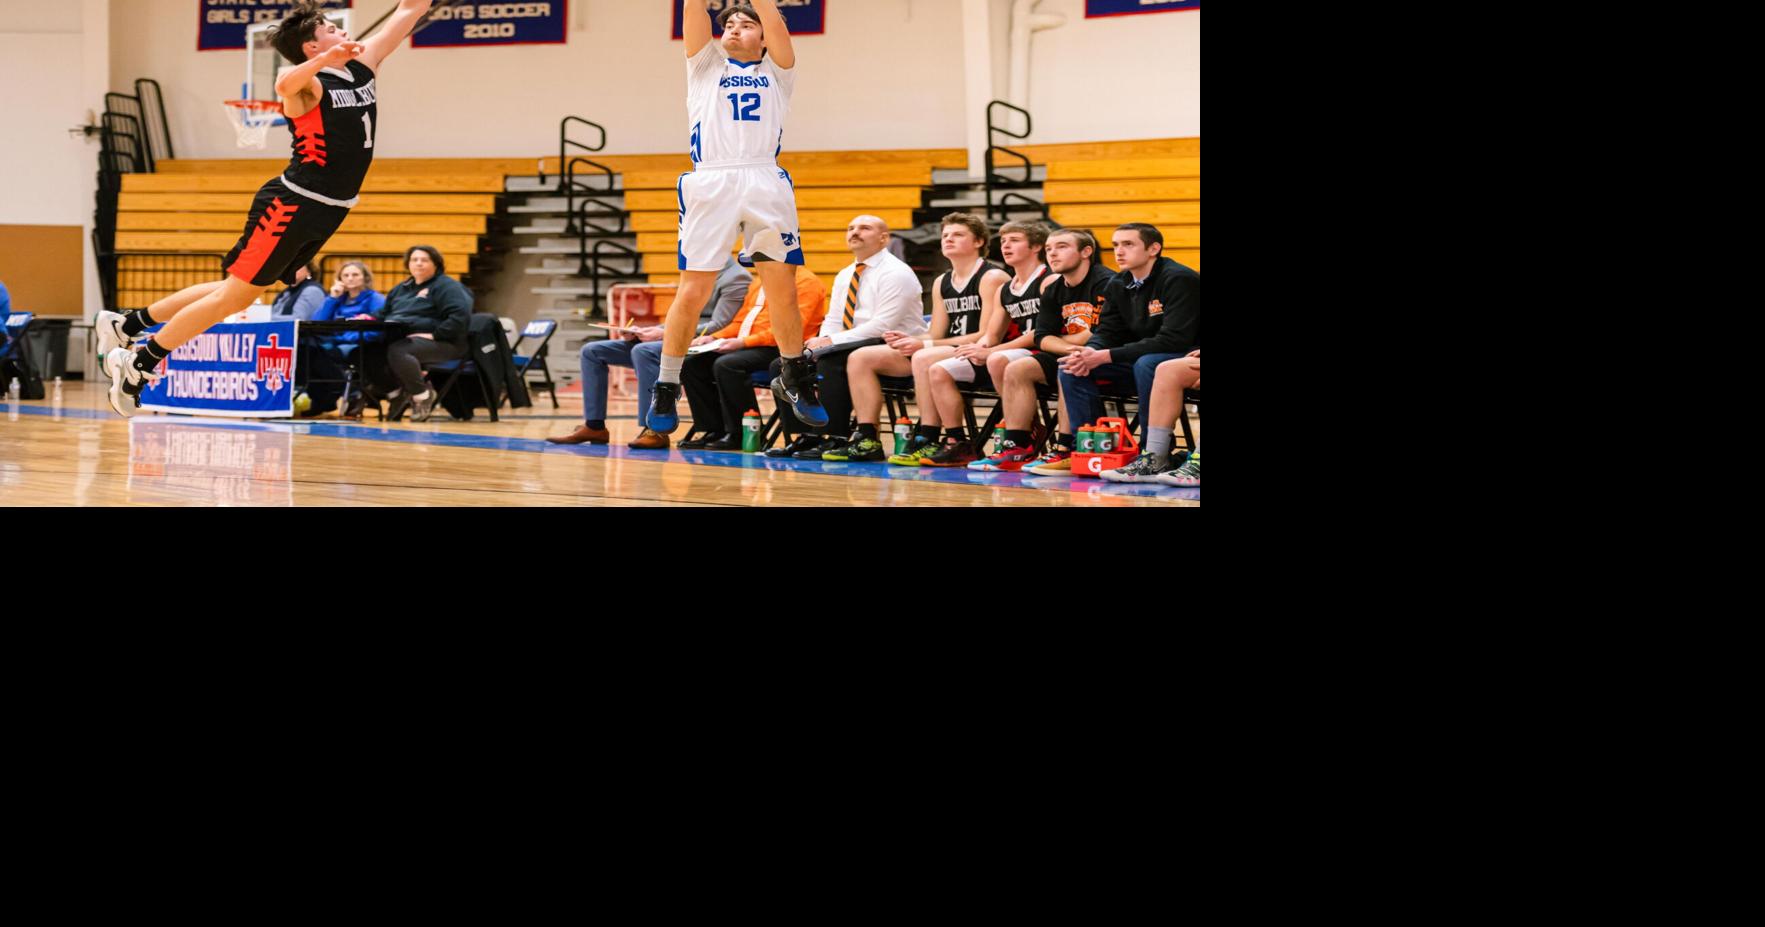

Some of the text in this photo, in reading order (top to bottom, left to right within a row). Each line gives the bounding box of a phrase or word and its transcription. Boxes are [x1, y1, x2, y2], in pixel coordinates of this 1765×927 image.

[207, 9, 249, 23] GIRLS
[478, 3, 551, 19] SOCCER
[463, 23, 515, 38] 2010
[727, 93, 761, 121] 12
[361, 111, 373, 148] 1
[166, 369, 259, 401] THUNDERBIRDS
[1088, 457, 1102, 473] G
